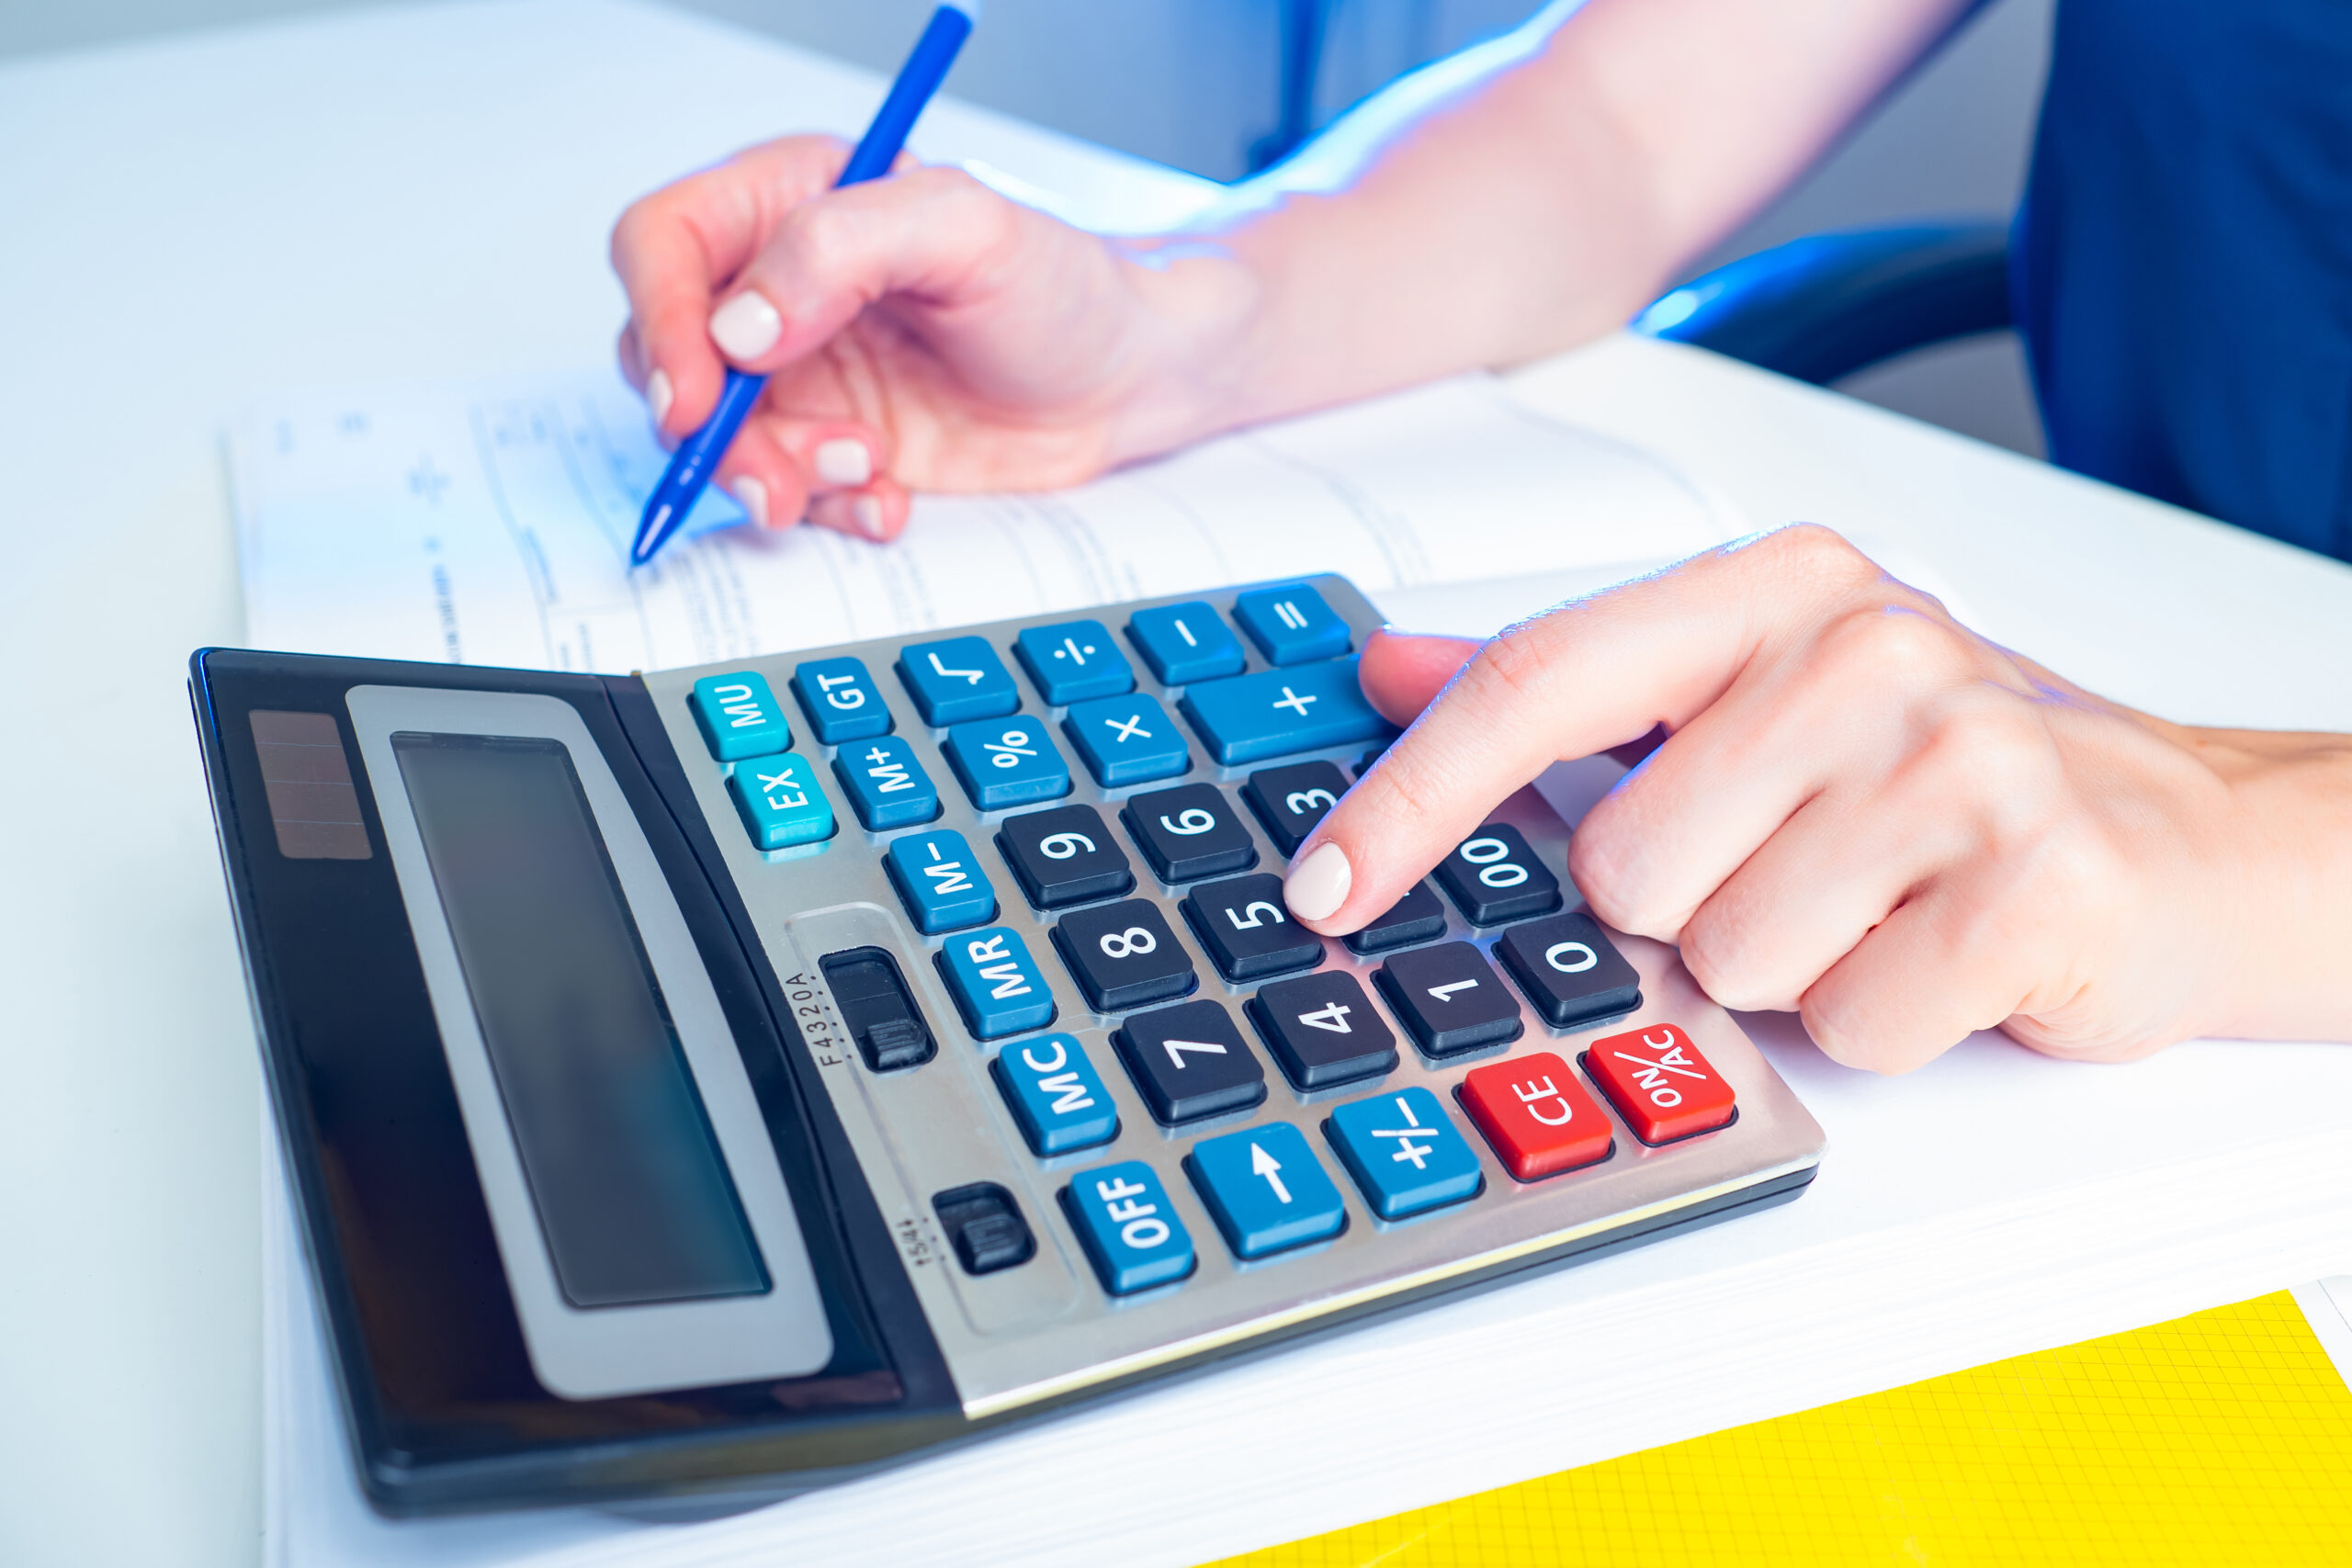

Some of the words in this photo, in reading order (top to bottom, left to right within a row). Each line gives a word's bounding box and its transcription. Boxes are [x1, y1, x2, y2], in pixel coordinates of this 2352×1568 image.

[714, 683, 767, 728] MU
[816, 673, 866, 710] GT
[983, 730, 1037, 768] %
[756, 768, 809, 810] EX
[865, 747, 917, 794] M+
[1286, 788, 1338, 816] 3
[1159, 808, 1215, 835] 6
[1039, 832, 1096, 859] 9
[1459, 837, 1529, 888] 00
[922, 841, 975, 896] M-
[1225, 900, 1284, 931] 5
[1100, 927, 1157, 959] 8
[1544, 942, 1598, 973] 0
[967, 933, 1034, 1000] MR
[1427, 978, 1479, 1002] 1
[1297, 1001, 1352, 1034] 4
[1162, 1039, 1227, 1069] 7
[1022, 1041, 1096, 1115] MC
[1511, 1075, 1574, 1126] CE
[1096, 1177, 1171, 1249] OFF
